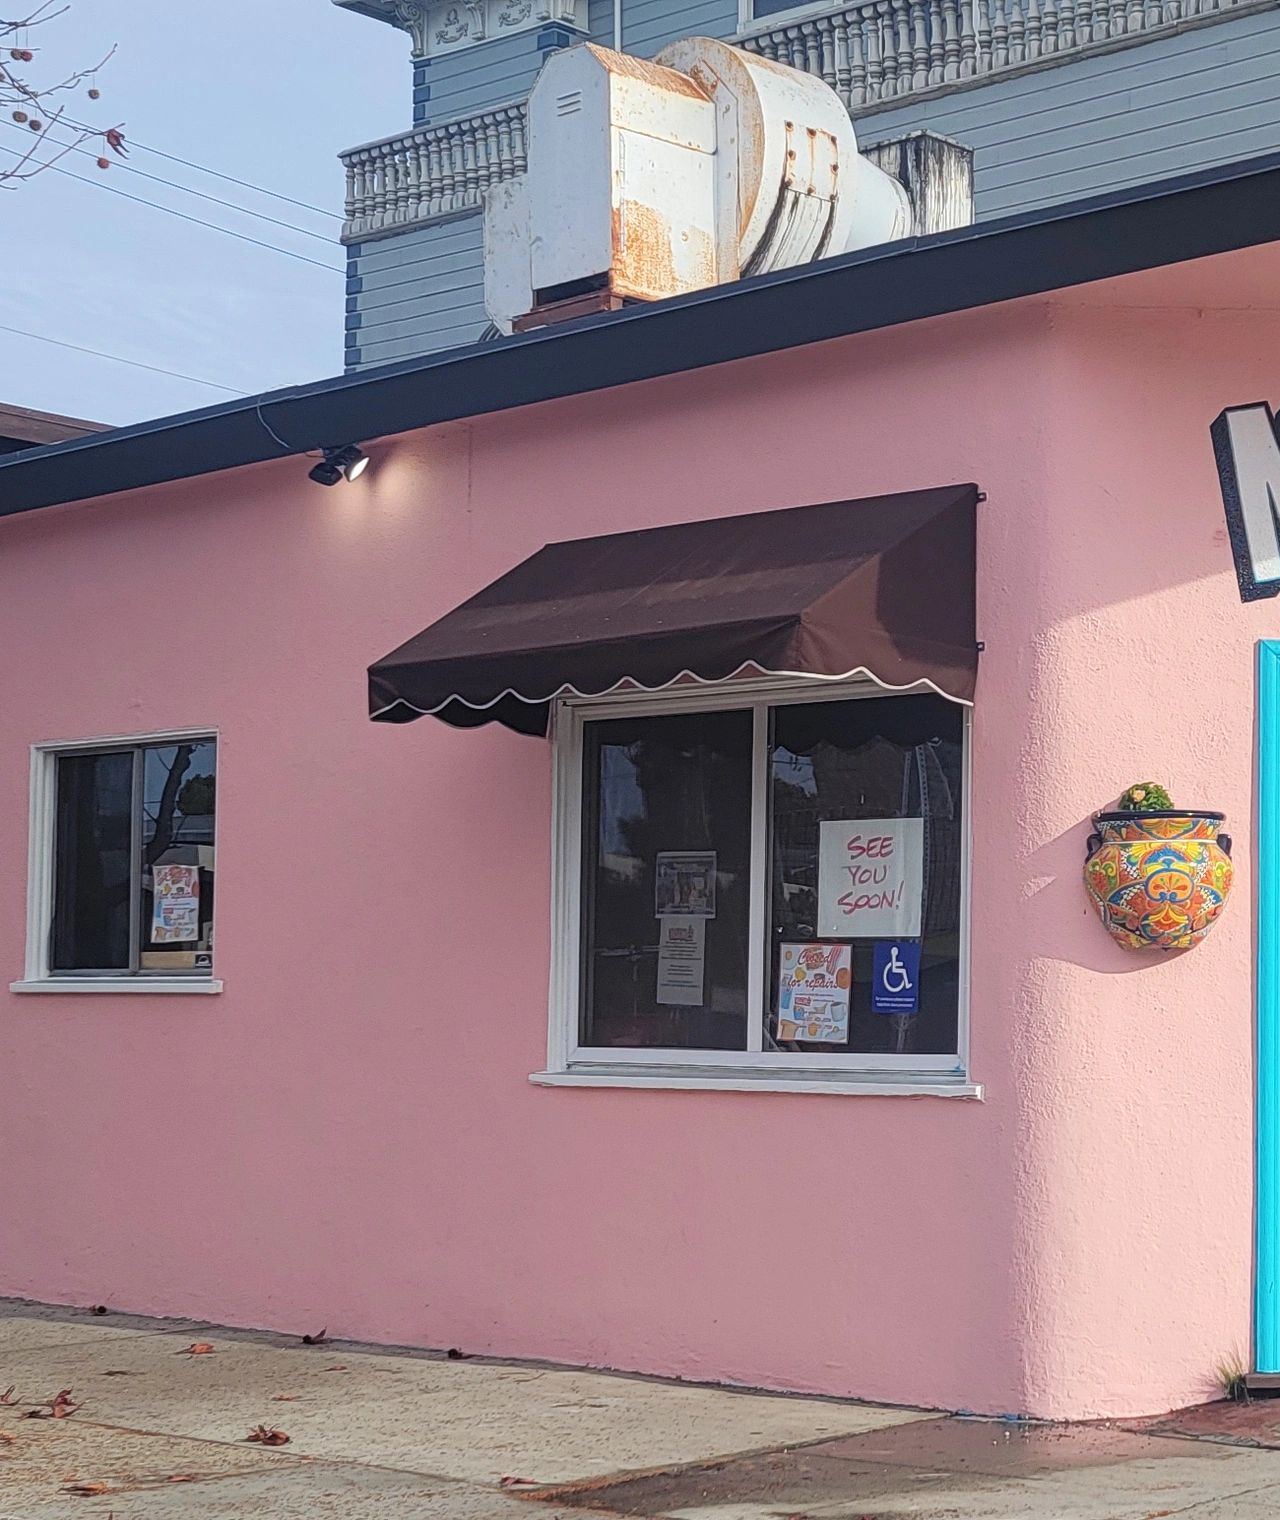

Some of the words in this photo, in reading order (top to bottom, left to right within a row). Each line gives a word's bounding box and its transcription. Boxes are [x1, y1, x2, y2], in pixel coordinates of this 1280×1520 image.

[847, 835, 894, 860] SEE
[841, 865, 887, 886] YOU
[837, 880, 905, 915] SOON!
